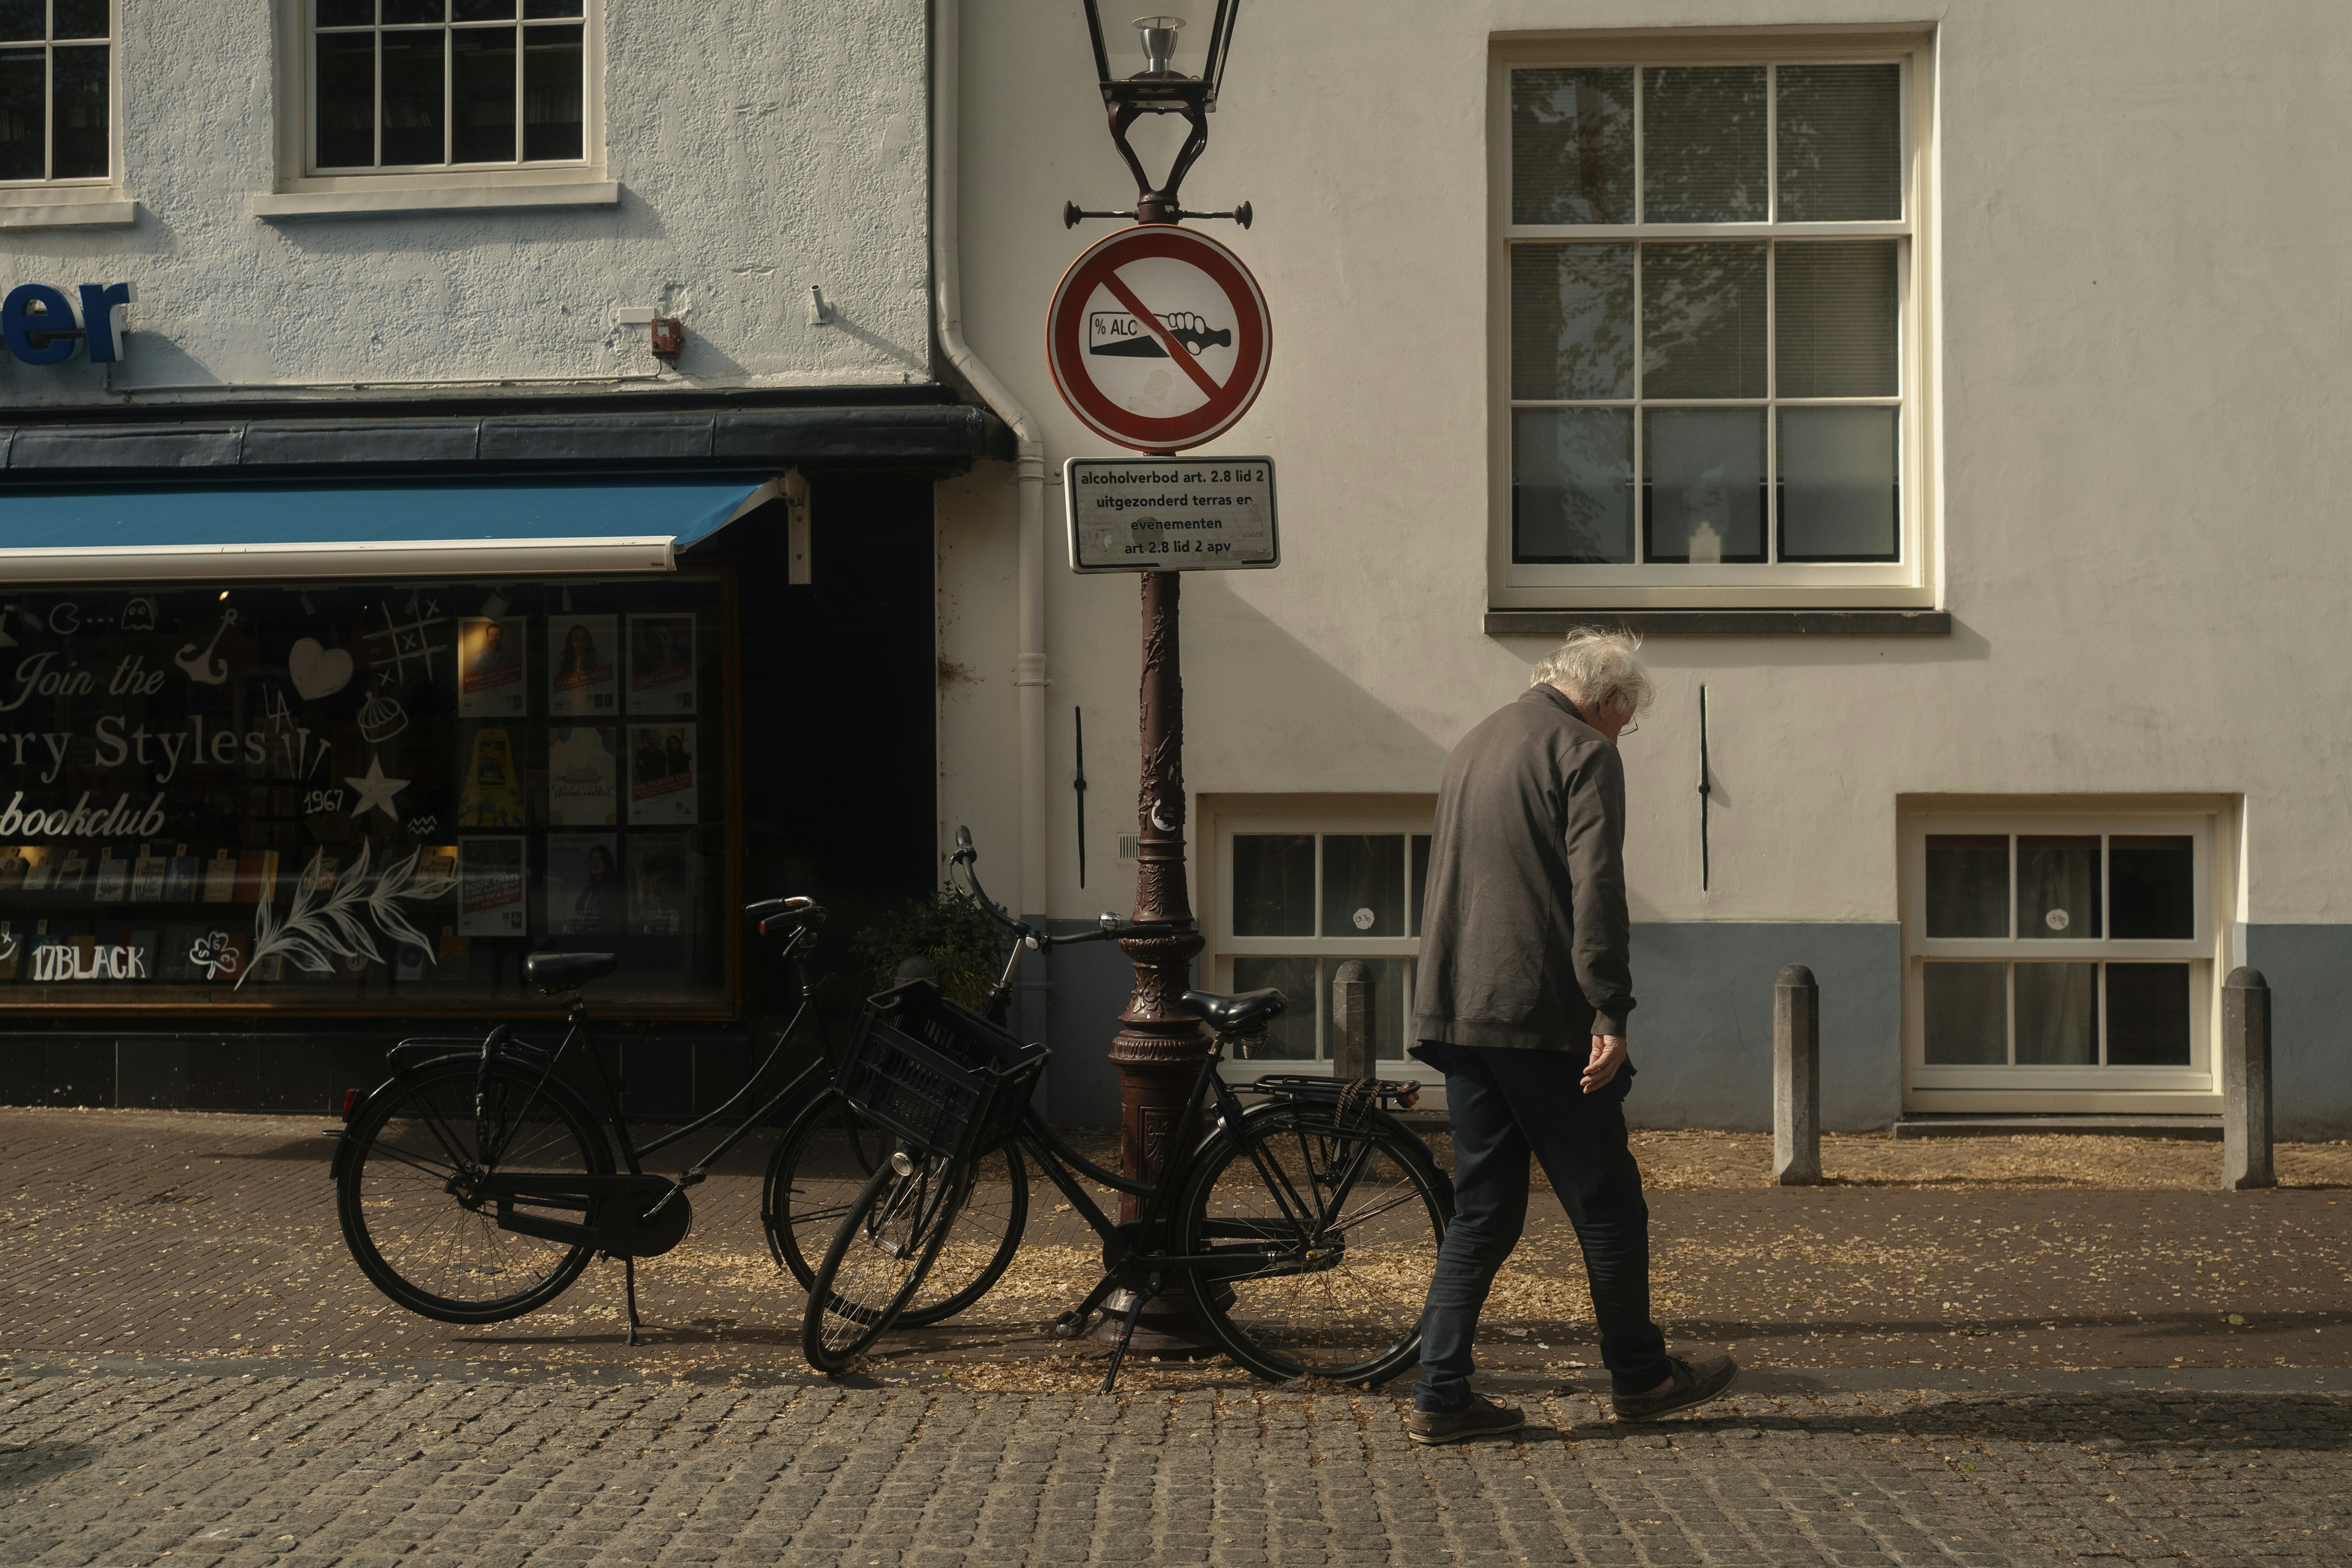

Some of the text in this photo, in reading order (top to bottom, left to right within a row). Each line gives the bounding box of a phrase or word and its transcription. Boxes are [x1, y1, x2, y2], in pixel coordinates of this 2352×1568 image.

[1110, 318, 1138, 335] ALC
[1081, 470, 1264, 484] alcoholverbod art. 2.8 lid 2
[1097, 494, 1187, 511] uitgezonderd
[1192, 495, 1232, 505] terras
[1131, 518, 1222, 530] evenementen
[1125, 540, 1230, 554] art 2.8 lid 2 apv
[0, 652, 165, 711] Join the
[557, 677, 578, 686] HAZEL
[581, 670, 609, 681] McBRIDE
[639, 677, 653, 685] LISA
[95, 715, 266, 784] Styles
[648, 777, 674, 787] PICKLED
[303, 790, 343, 814] 1967
[0, 791, 165, 837] bookclub
[466, 873, 519, 891] BOOK CHATS
[484, 881, 519, 892] AMSTERDAM
[464, 896, 483, 905] DIARY
[1026, 1135, 1056, 1169] POINTER
